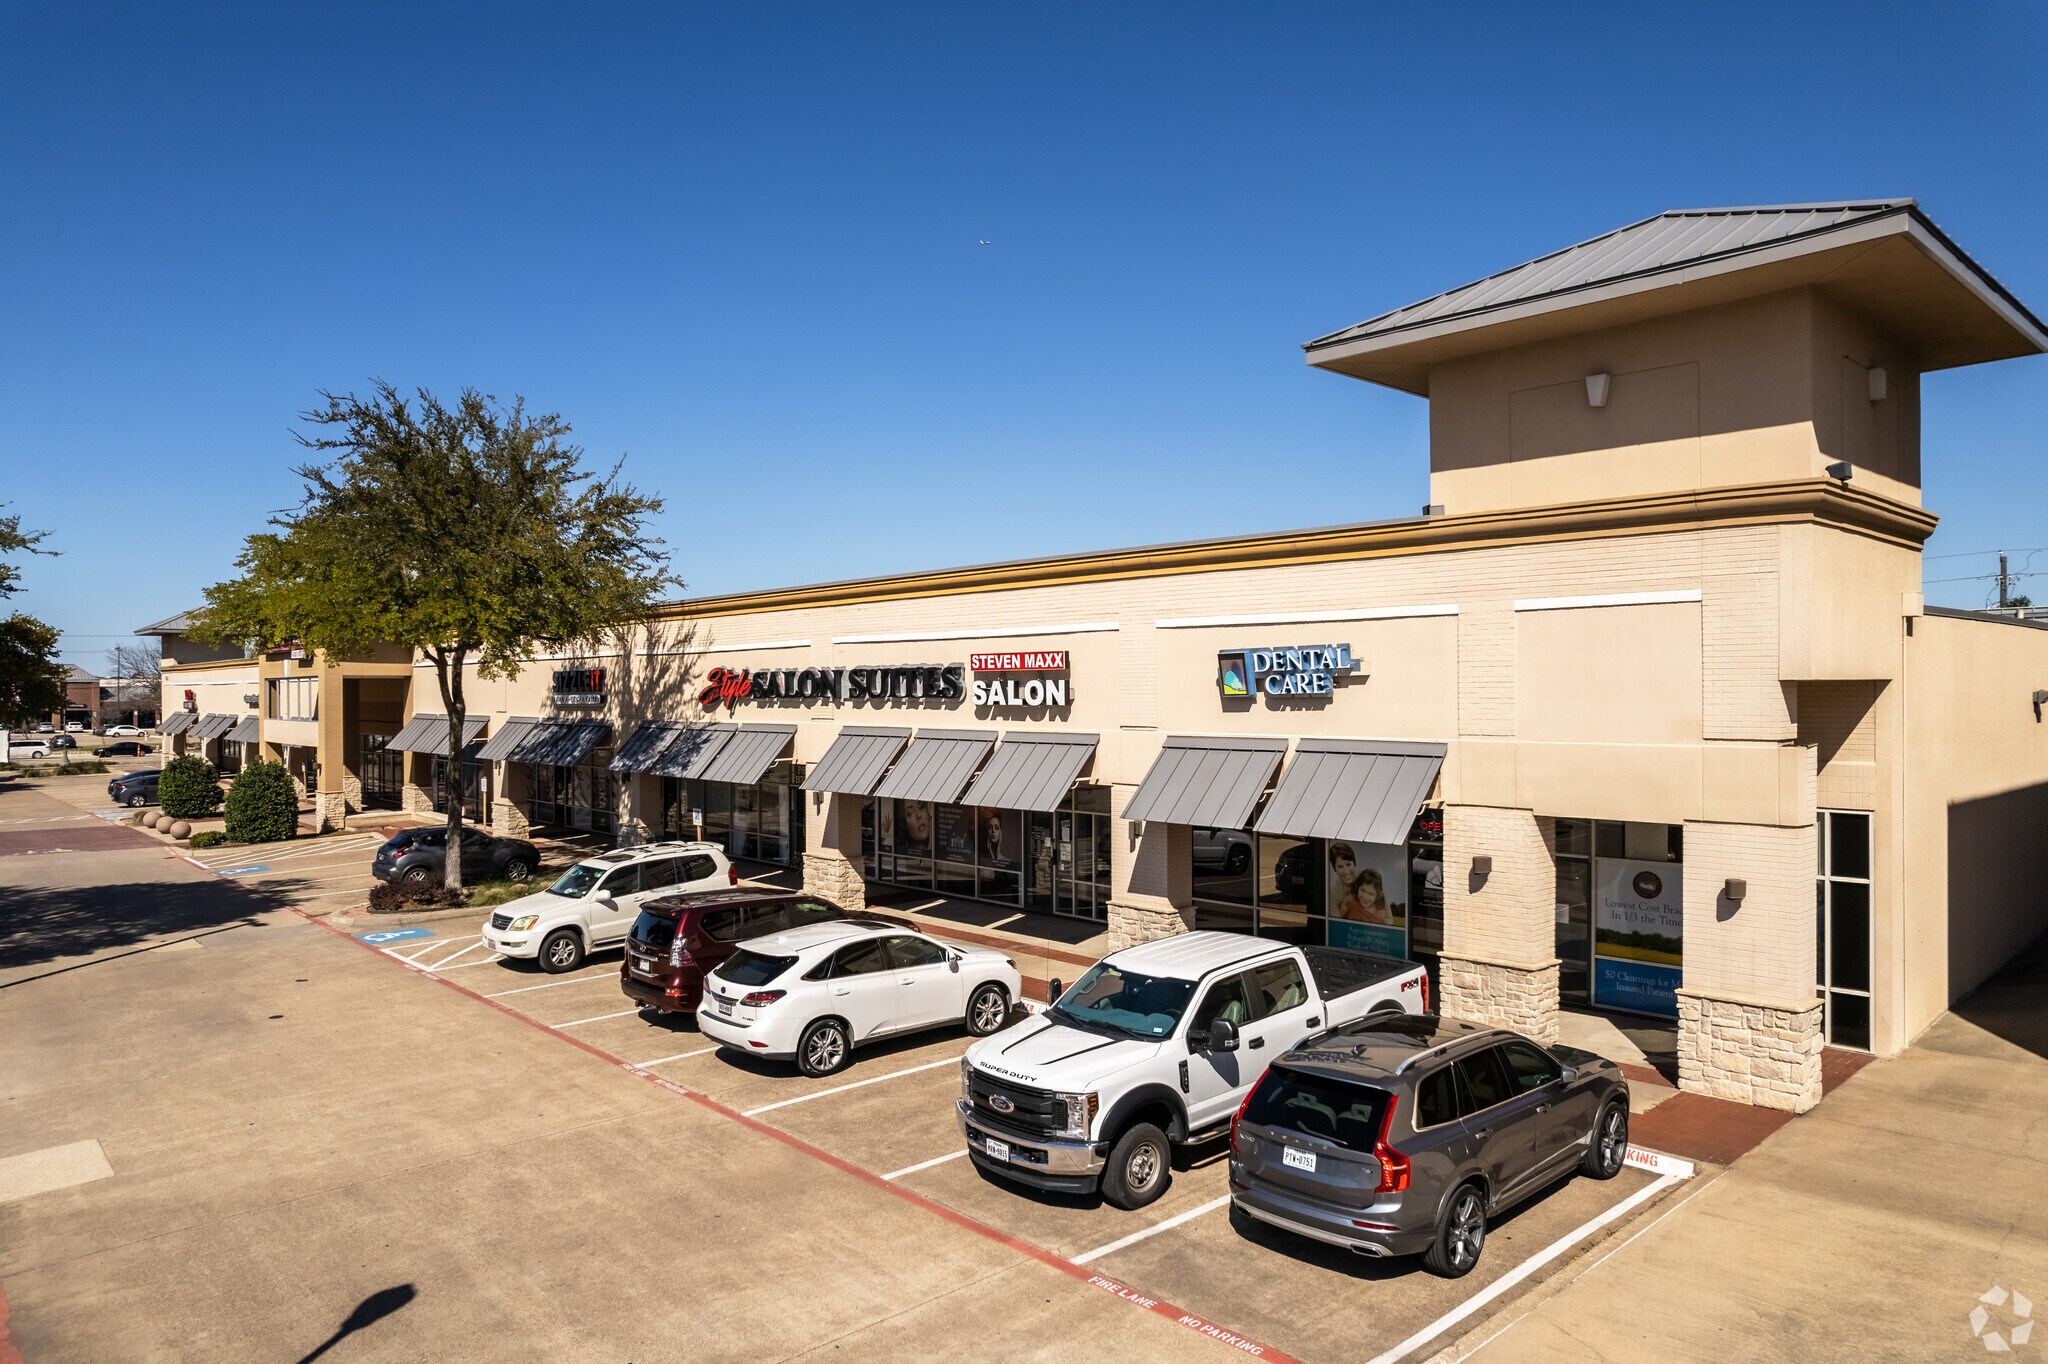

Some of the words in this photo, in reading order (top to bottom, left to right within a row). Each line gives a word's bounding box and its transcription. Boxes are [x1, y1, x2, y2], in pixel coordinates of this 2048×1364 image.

[971, 653, 1021, 669] STEVEN
[1024, 652, 1064, 668] MAXX
[1252, 647, 1351, 673] DENTAL
[698, 667, 752, 711] Style
[752, 669, 845, 699] SALON
[848, 665, 966, 700] SUITES
[971, 678, 1066, 707] SALON
[1265, 673, 1326, 695] CARE
[1420, 821, 1441, 831] OPE
[1604, 897, 1636, 910] Lowest
[1638, 901, 1660, 913] Cost
[1663, 904, 1683, 915] Brac
[1611, 910, 1621, 920] In
[1625, 911, 1638, 922] 1/3
[1640, 913, 1656, 924] the
[1659, 915, 1683, 927] Time
[1605, 969, 1616, 979] $0
[1617, 971, 1656, 985] Cleanings
[1658, 977, 1670, 987] for
[1616, 981, 1645, 994] Insured
[979, 1061, 1009, 1075] SUPER
[1009, 1071, 1038, 1082] DUTY
[1626, 1148, 1658, 1167] KING
[1088, 1275, 1121, 1294] FIRE
[1118, 1289, 1158, 1309] LANE
[1178, 1315, 1202, 1328] NO
[1200, 1324, 1264, 1356] PARKING
